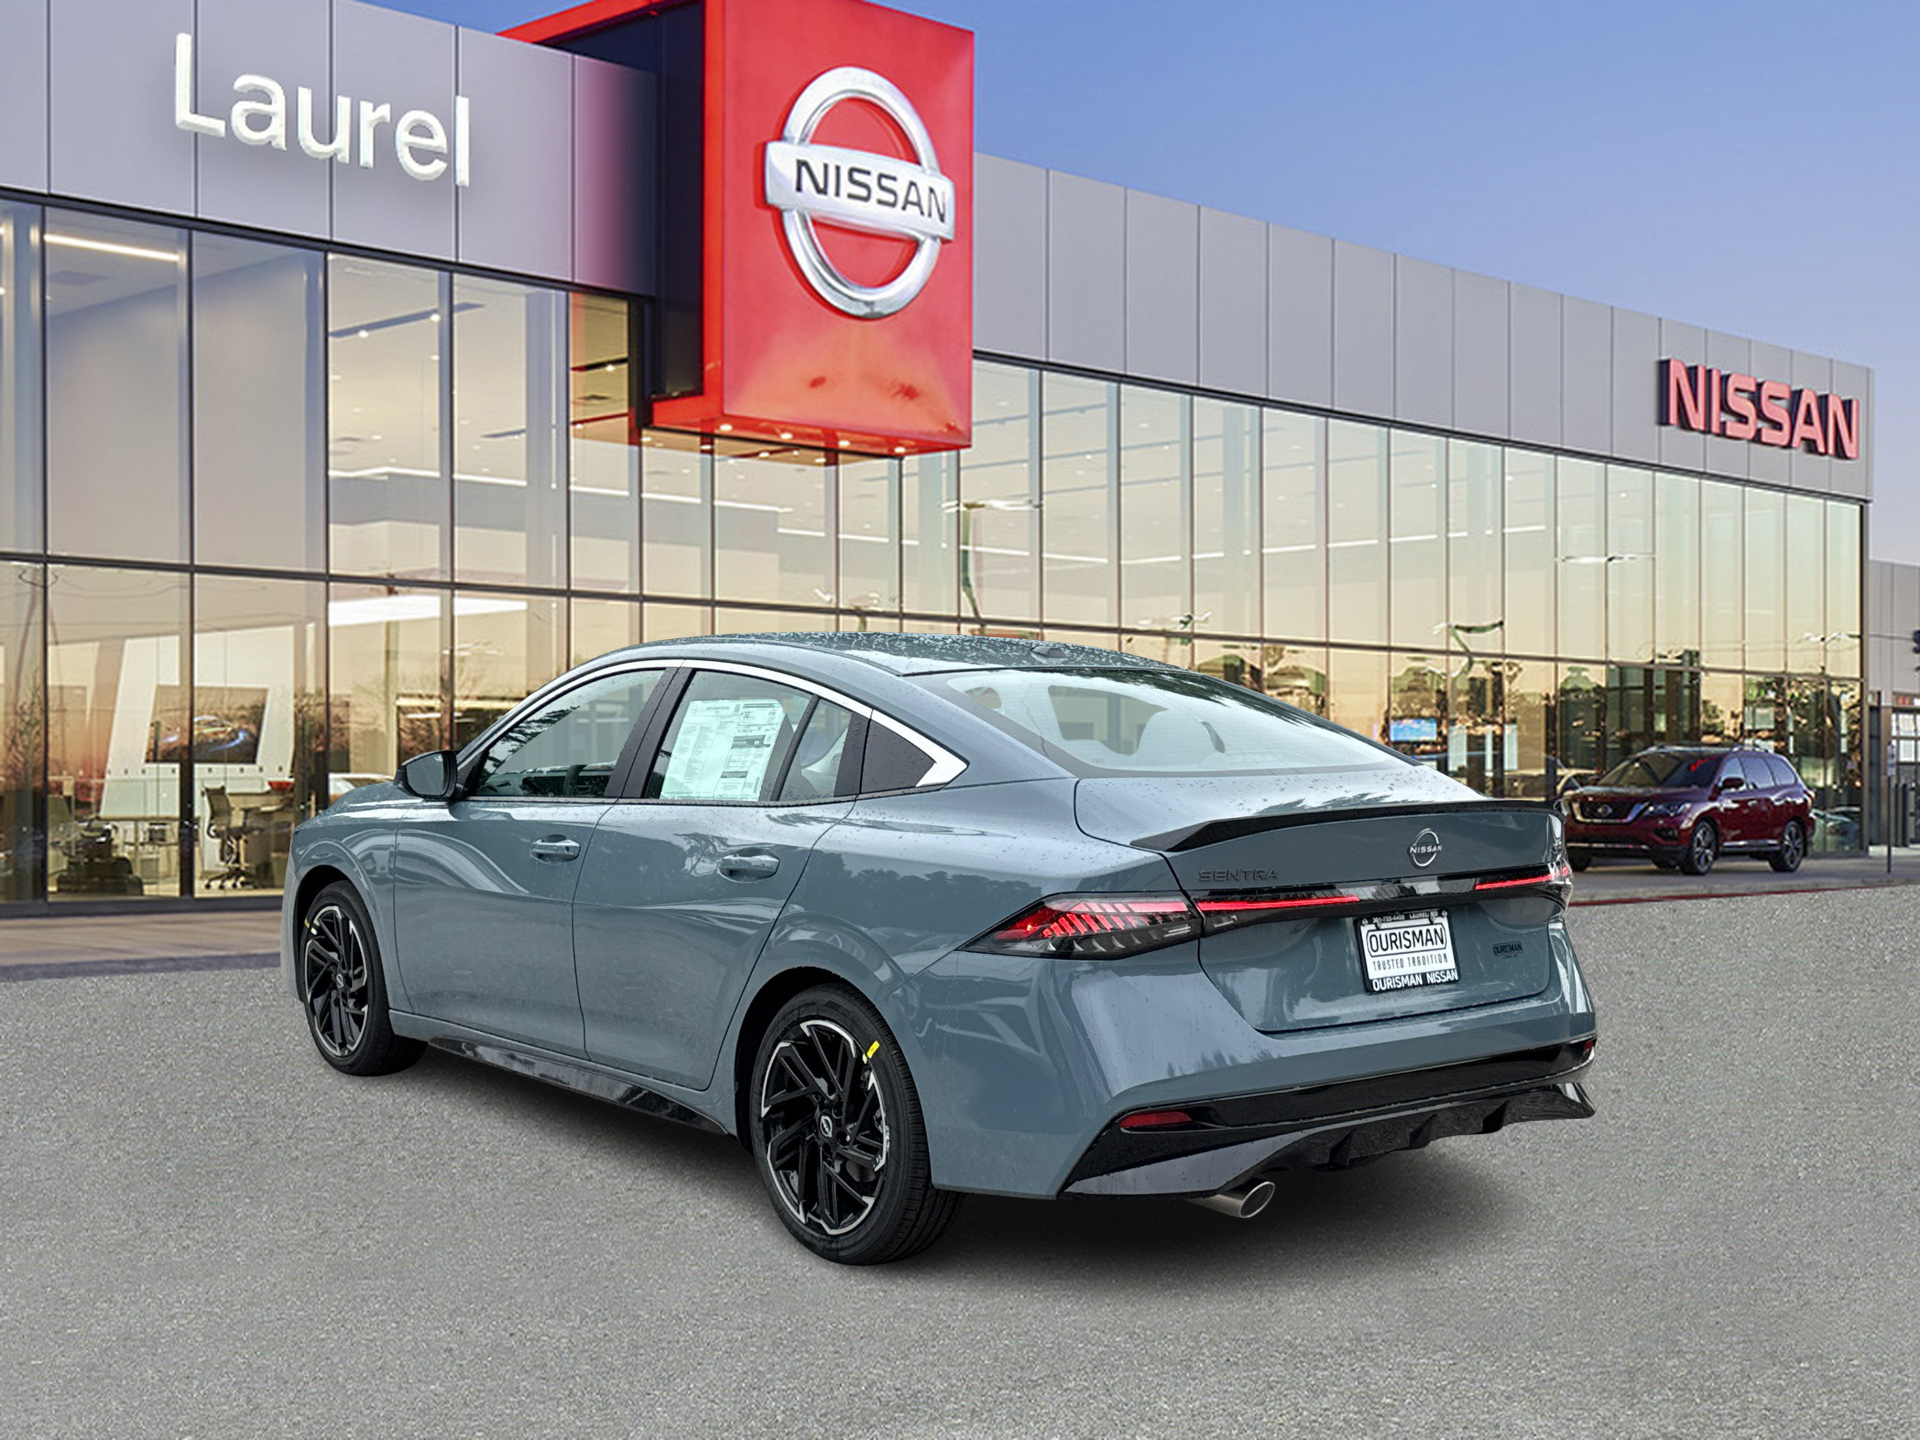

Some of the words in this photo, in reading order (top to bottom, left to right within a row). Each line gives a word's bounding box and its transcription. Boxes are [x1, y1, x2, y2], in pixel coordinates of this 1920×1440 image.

[175, 33, 469, 187] Laurel
[795, 159, 946, 224] NISSAN
[1659, 357, 1859, 460] NISSAN
[1410, 845, 1442, 853] NISSAN
[1199, 868, 1278, 882] SENTRA
[1369, 928, 1444, 953] OURISMAN
[1373, 957, 1404, 971] TRUSTED
[1407, 953, 1448, 968] TRADITION
[1373, 974, 1423, 991] OURISMAN
[1426, 969, 1458, 984] NISSAN
